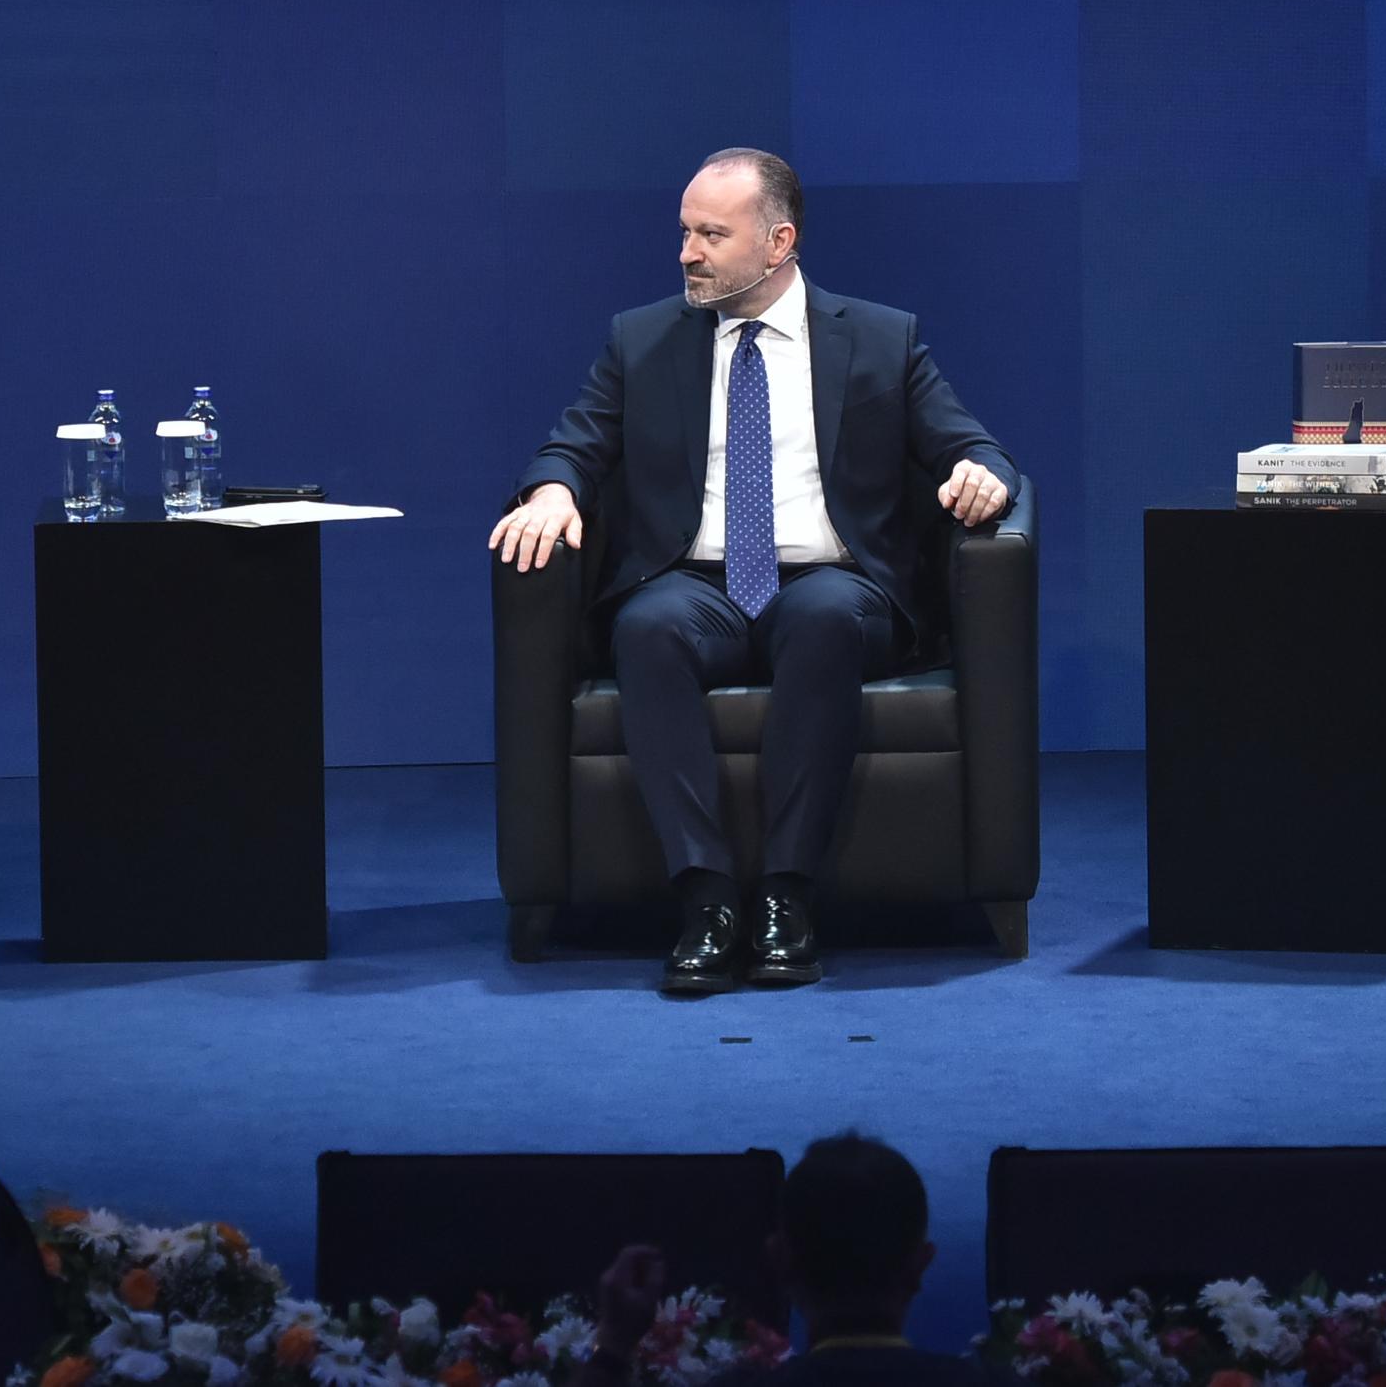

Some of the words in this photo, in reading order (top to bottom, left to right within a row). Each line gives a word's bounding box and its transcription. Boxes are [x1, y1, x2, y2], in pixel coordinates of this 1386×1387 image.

[1308, 460, 1346, 468] EVIDENCE
[1254, 497, 1281, 505] SANIK
[1286, 498, 1299, 506] THE
[1302, 498, 1357, 506] PERPETRATOR
